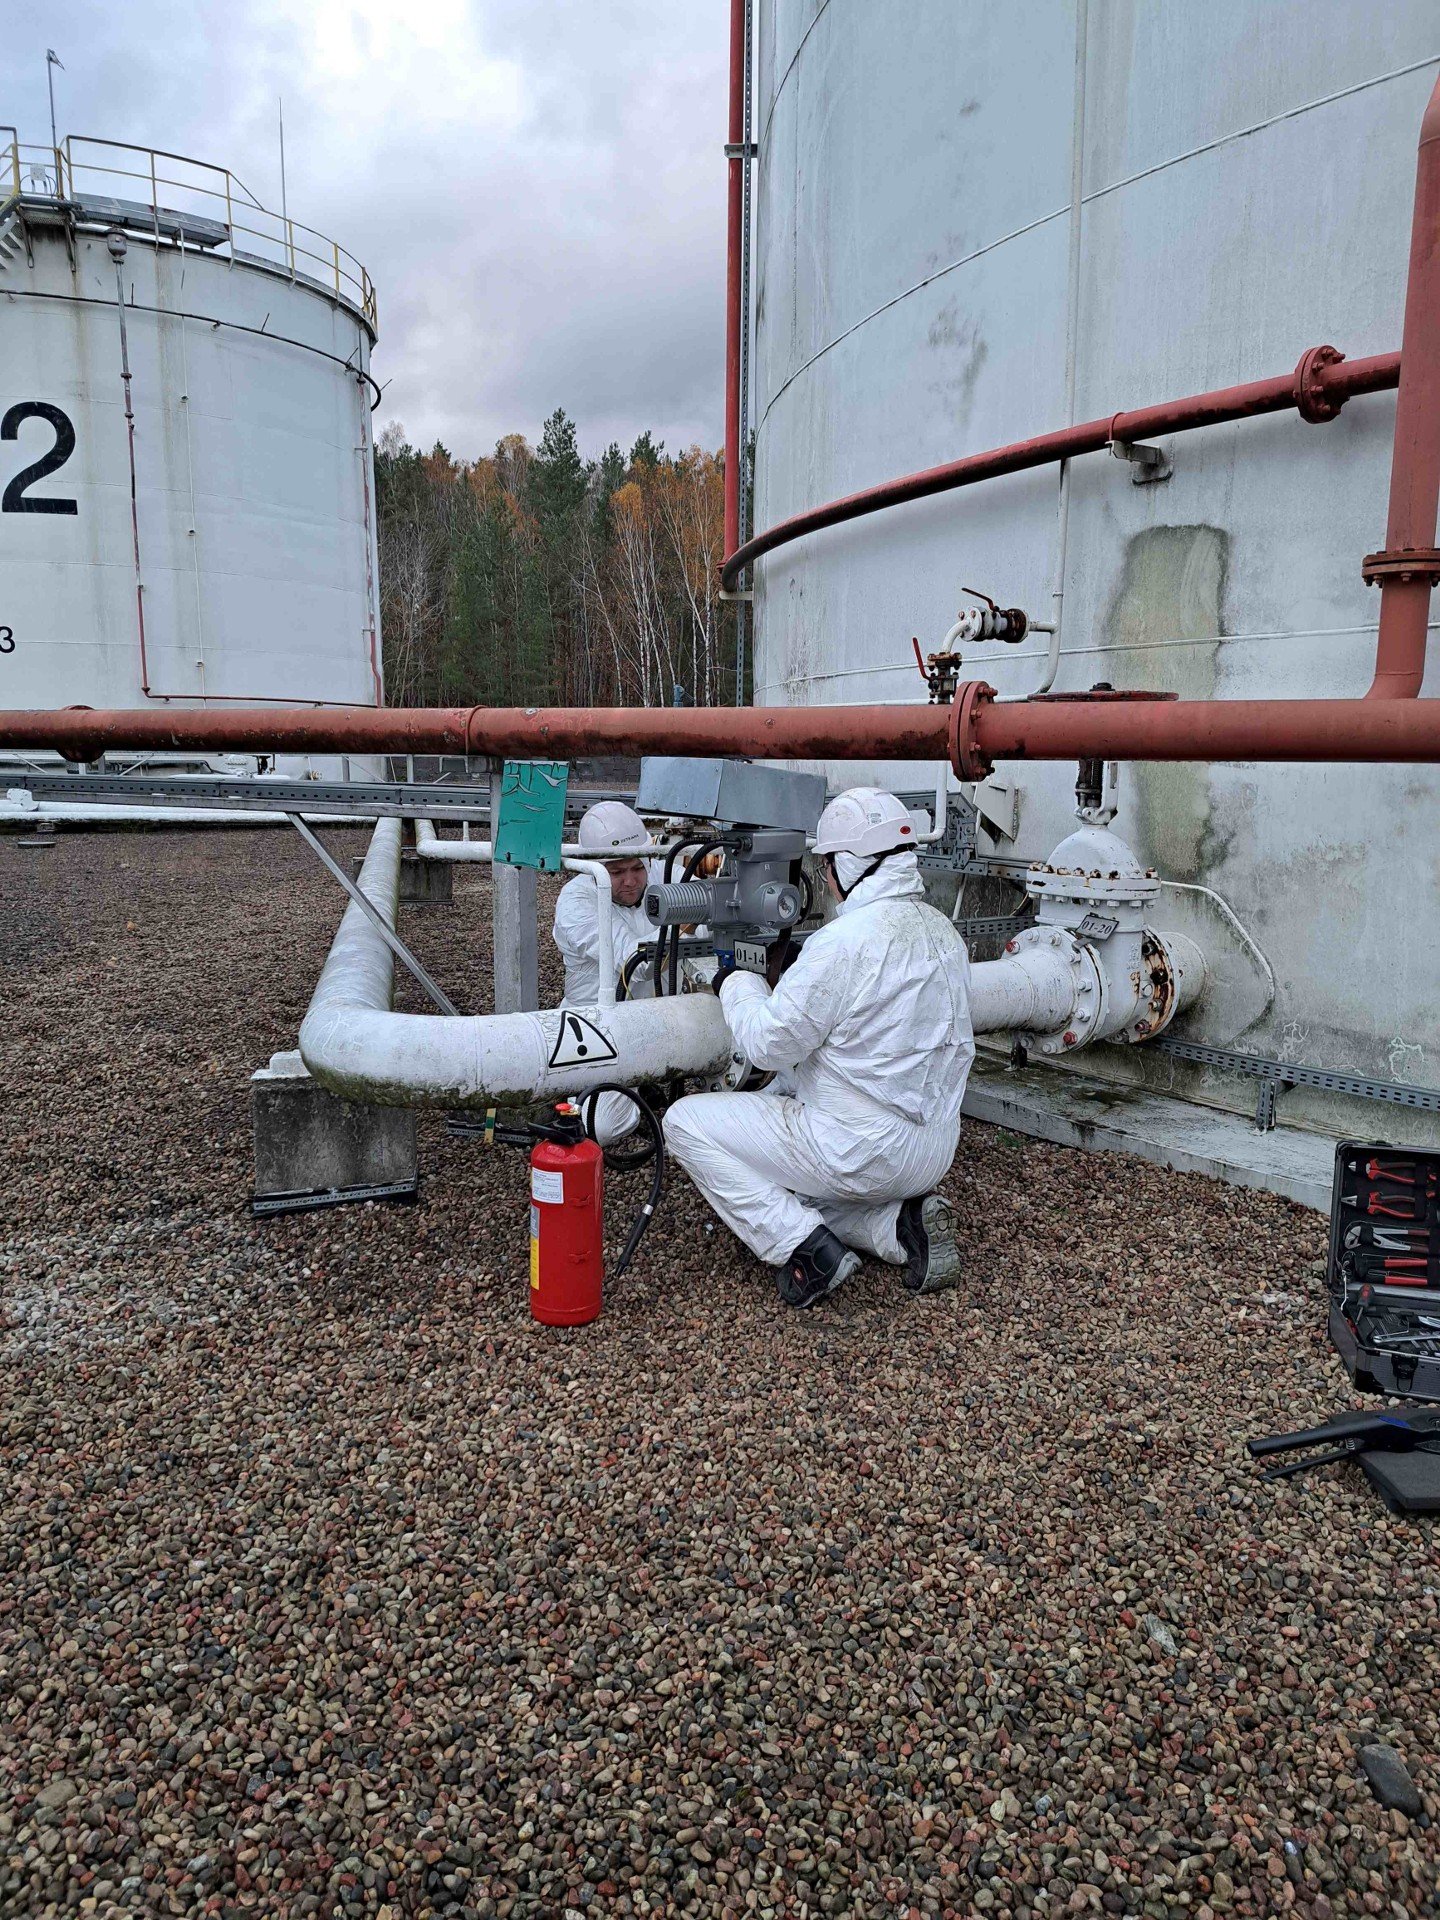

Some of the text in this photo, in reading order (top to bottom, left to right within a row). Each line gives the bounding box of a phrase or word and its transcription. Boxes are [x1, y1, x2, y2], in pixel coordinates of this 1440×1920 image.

[1, 401, 78, 515] 2
[0, 626, 16, 653] 3
[1082, 921, 1112, 934] 01-20
[736, 948, 765, 966] 01-14
